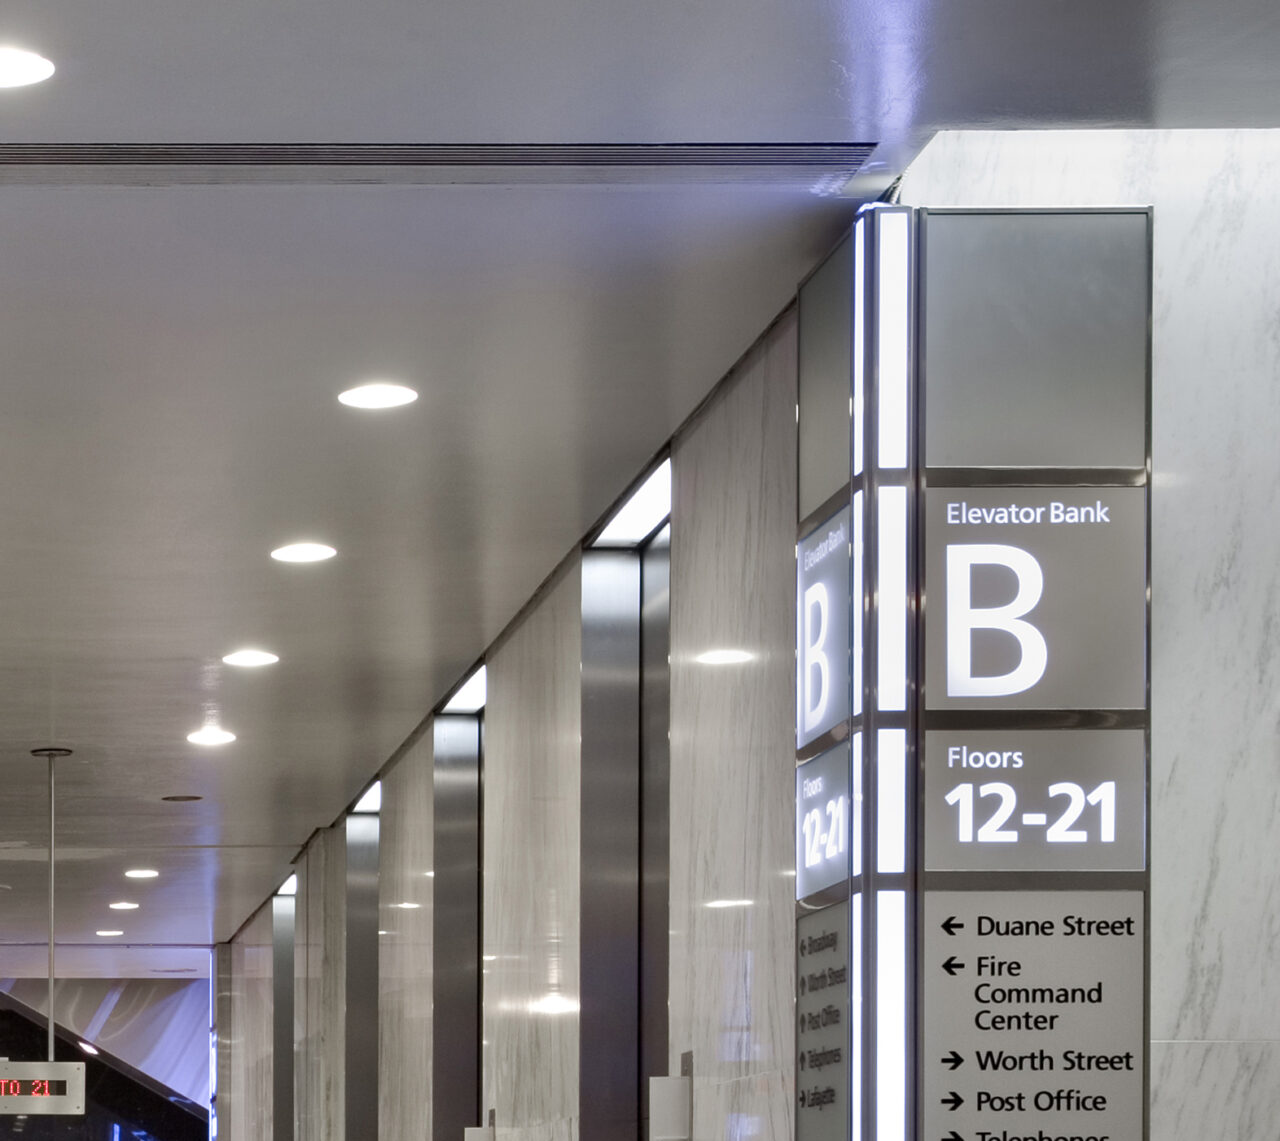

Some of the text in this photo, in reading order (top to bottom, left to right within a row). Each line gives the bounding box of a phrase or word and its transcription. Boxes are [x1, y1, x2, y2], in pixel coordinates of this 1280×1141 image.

[948, 501, 1110, 523] Elevator Bank
[946, 544, 1048, 697] B
[804, 582, 830, 733] B
[949, 746, 1023, 768] Floors
[945, 781, 1116, 843] 12-21
[802, 795, 844, 868] 12-21
[978, 916, 1134, 936] Duane Street
[978, 956, 1021, 976] Fire
[975, 982, 1102, 1003] Command
[975, 1010, 1059, 1030] Center
[976, 1050, 1133, 1070] Worth Street
[31, 1080, 51, 1097] 21
[977, 1090, 1106, 1111] Post Office
